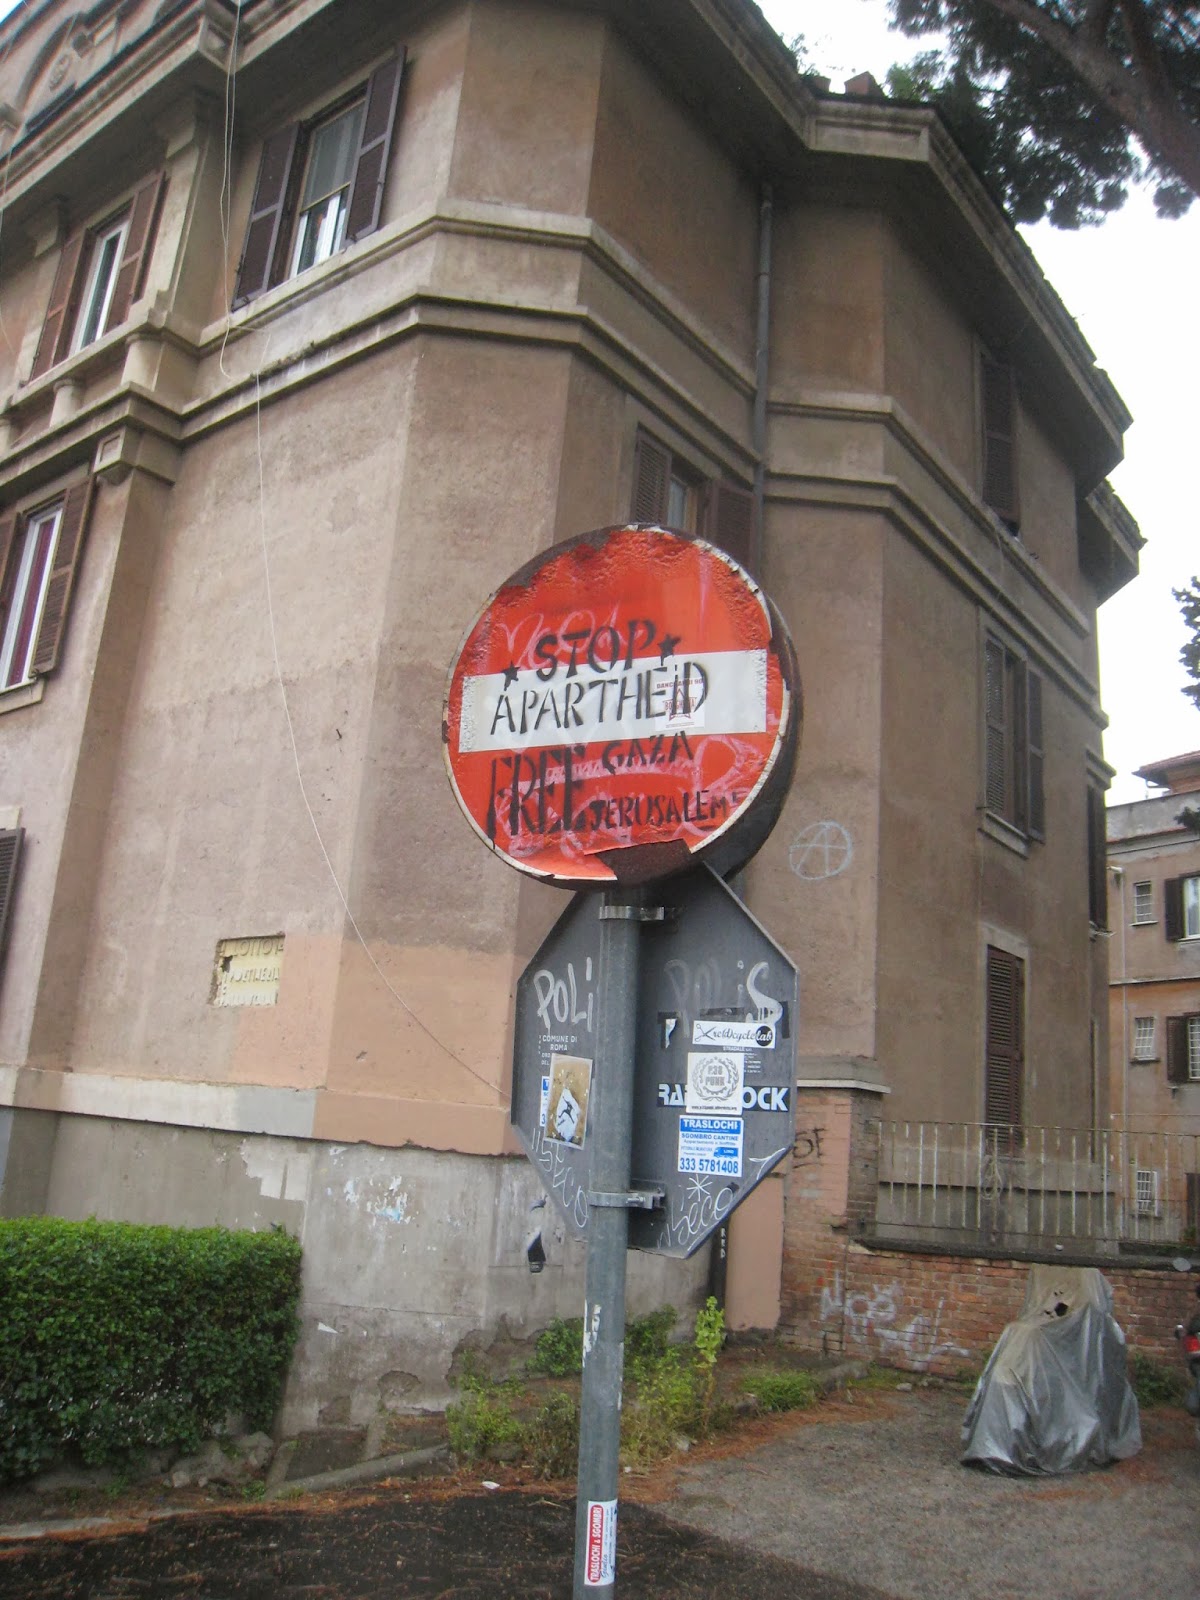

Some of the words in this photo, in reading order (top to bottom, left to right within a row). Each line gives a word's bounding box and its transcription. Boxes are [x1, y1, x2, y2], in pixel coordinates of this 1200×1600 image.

[536, 619, 657, 681] STOP
[490, 661, 709, 735] APARTHEID
[602, 731, 694, 775] GAZA
[542, 1035, 569, 1043] COMUNE
[570, 1035, 578, 1043] DI
[741, 1086, 789, 1112] OCK
[681, 1132, 713, 1140] SGOMBRO
[683, 1119, 739, 1130] TRASLOCHI
[679, 1157, 696, 1170] 333
[698, 1158, 739, 1174] 5781408
[590, 1544, 601, 1581] TRASLOCHI
